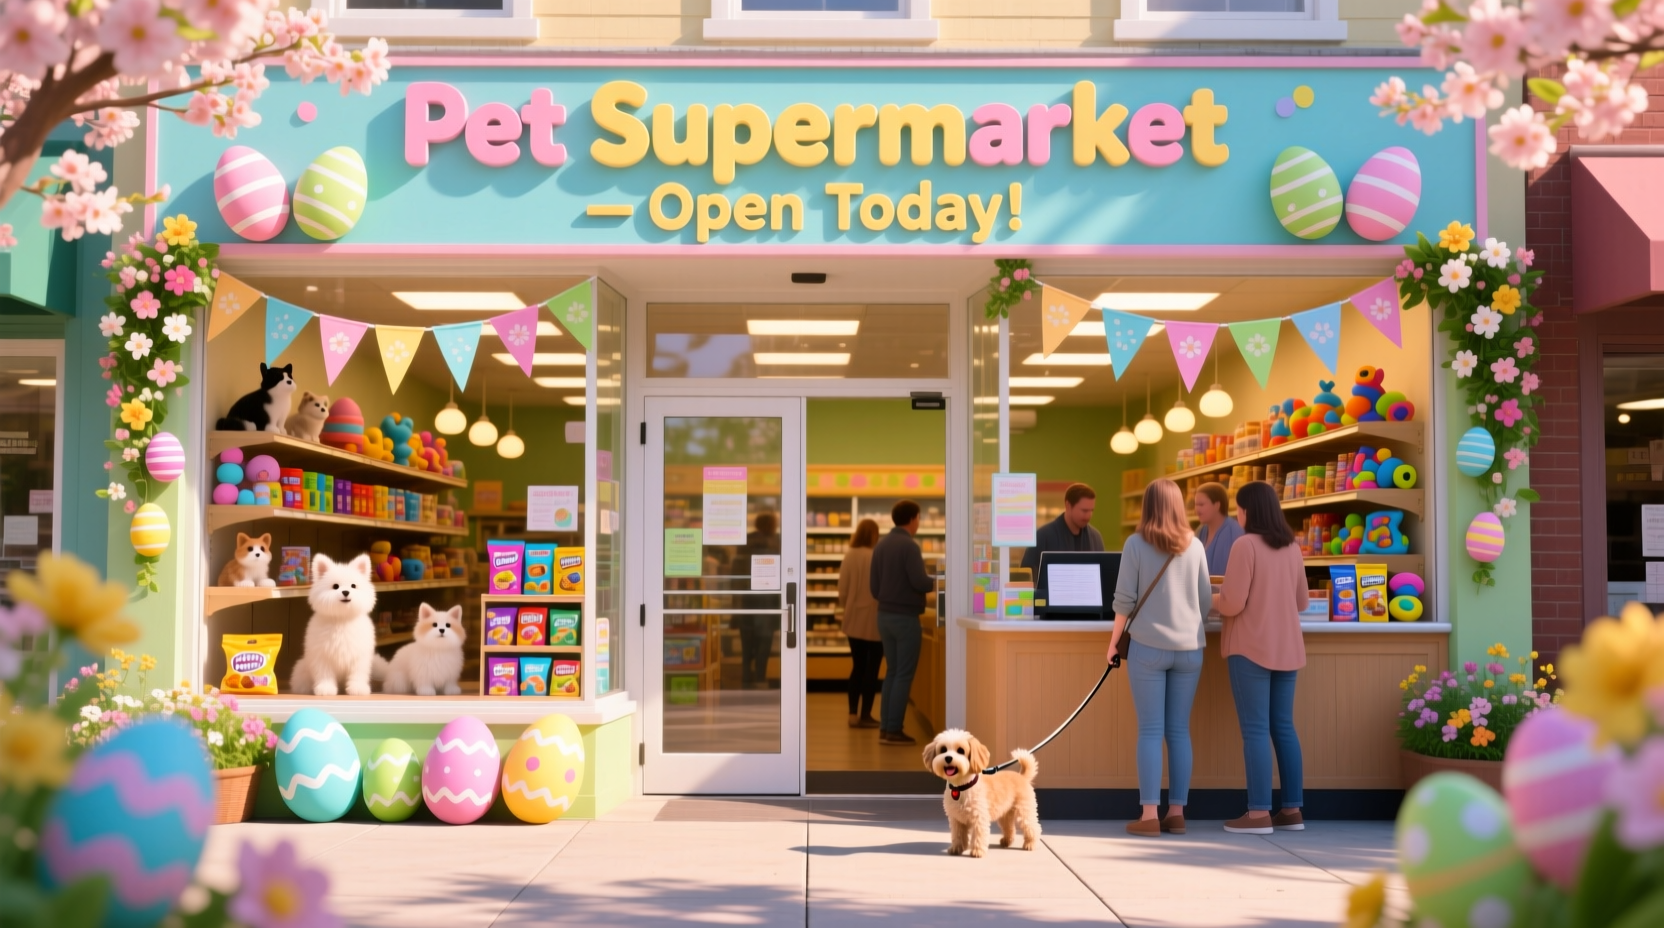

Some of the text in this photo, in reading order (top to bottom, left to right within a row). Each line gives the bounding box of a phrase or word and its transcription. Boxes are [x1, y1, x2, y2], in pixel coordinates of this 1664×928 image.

[404, 80, 1230, 186] Pet Supermarket
[648, 182, 803, 245] Open
[824, 179, 1024, 245] Today!
